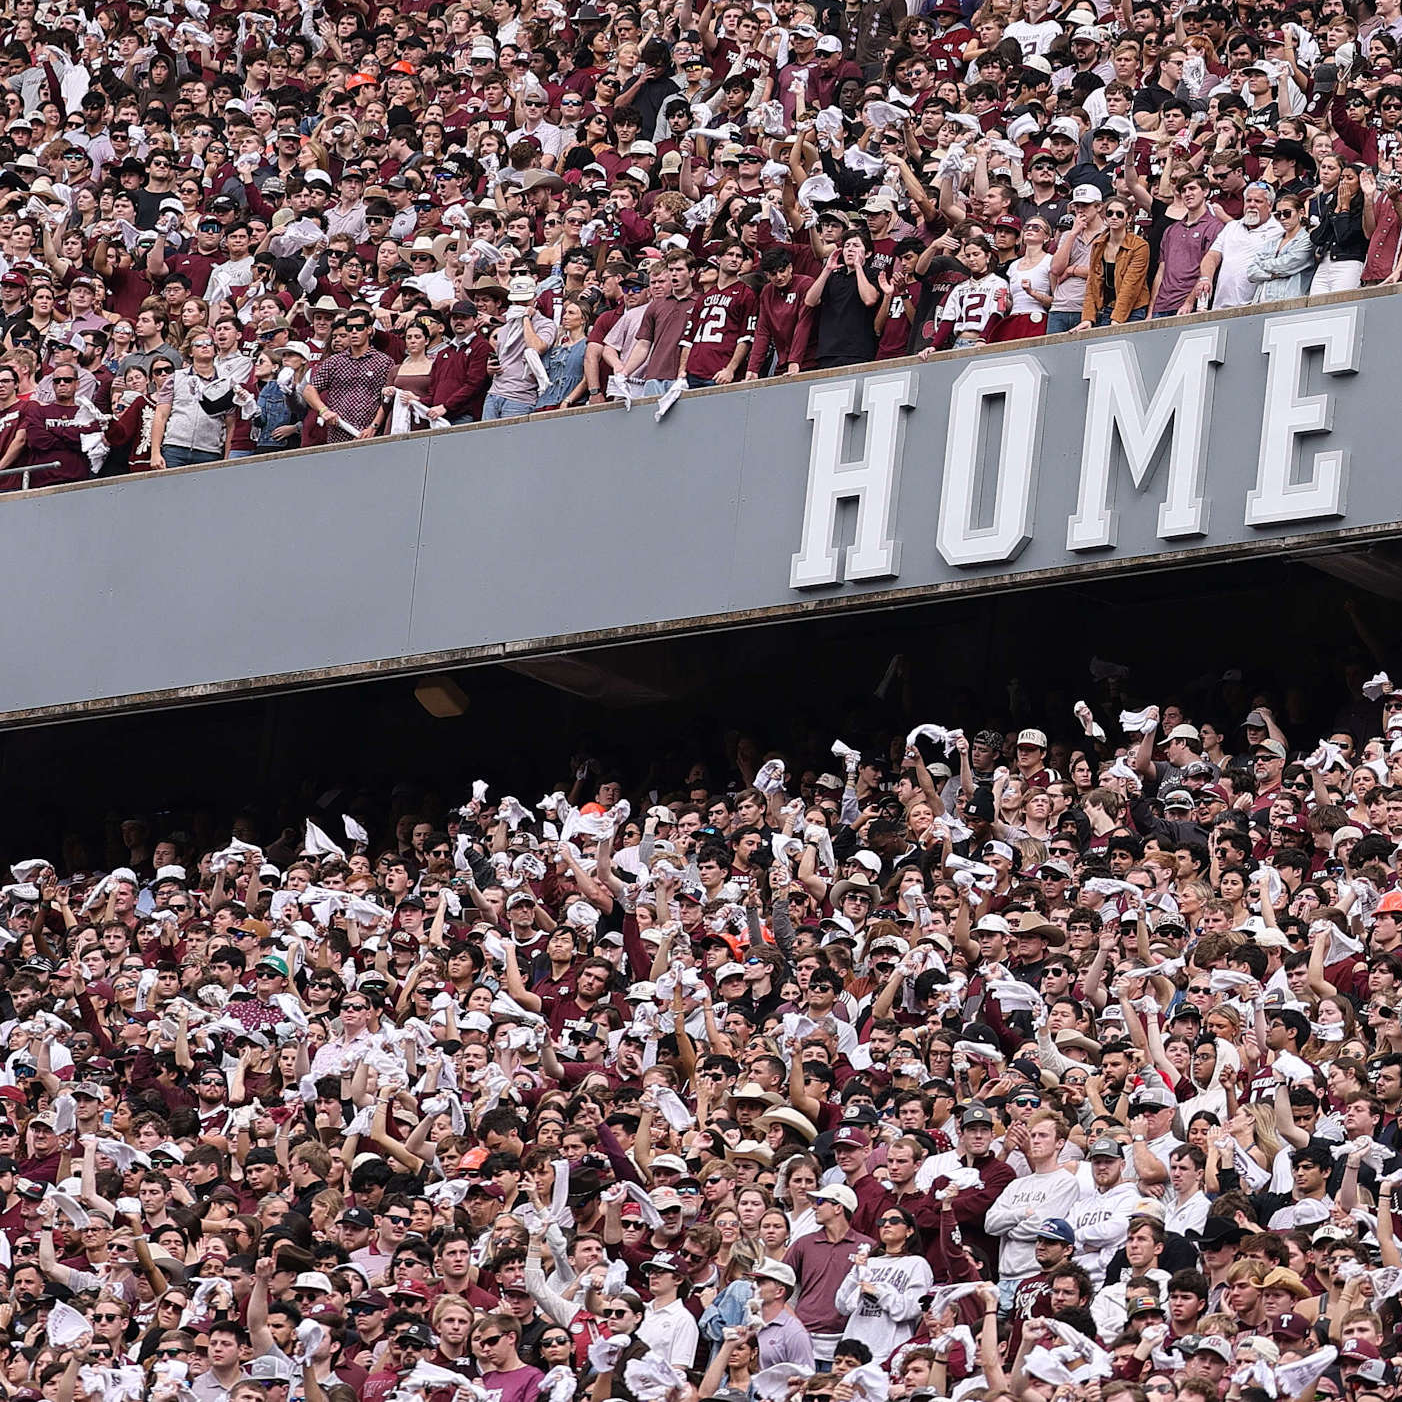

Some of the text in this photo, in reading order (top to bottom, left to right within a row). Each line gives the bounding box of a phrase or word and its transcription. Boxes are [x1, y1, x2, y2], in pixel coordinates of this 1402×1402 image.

[694, 306, 726, 342] 12
[790, 306, 1361, 588] HOME
[1280, 1316, 1292, 1328] T
